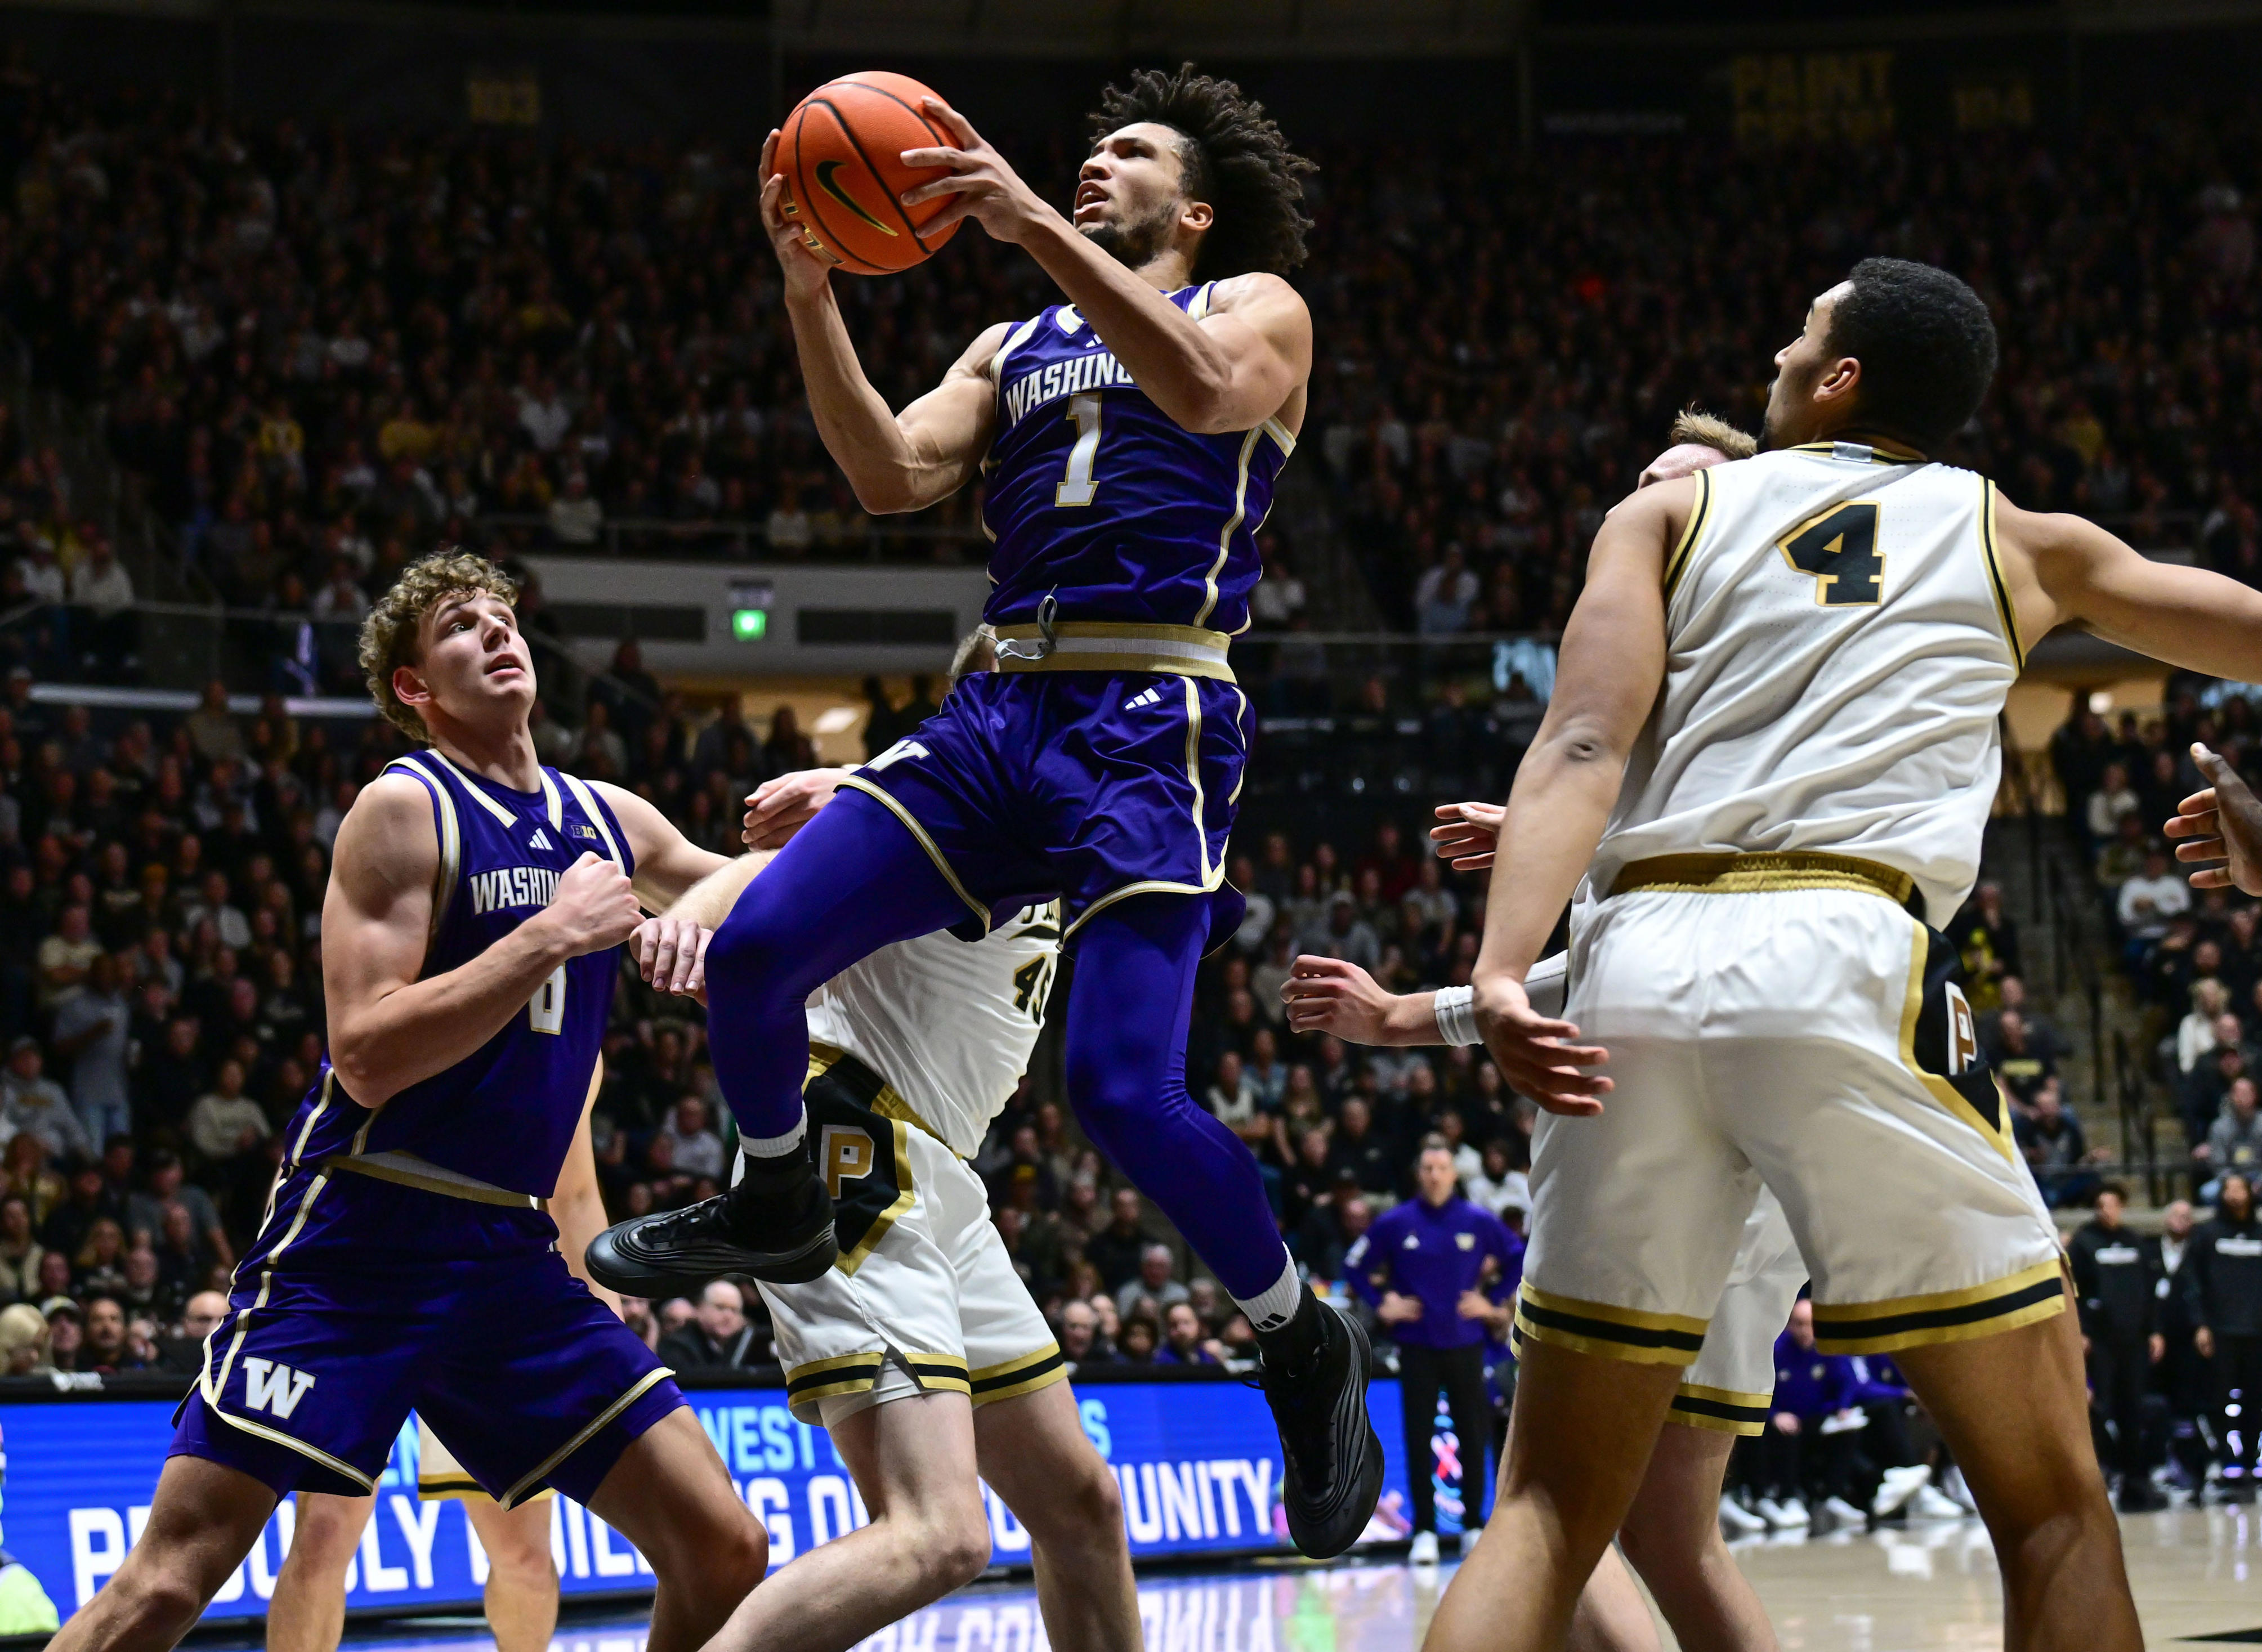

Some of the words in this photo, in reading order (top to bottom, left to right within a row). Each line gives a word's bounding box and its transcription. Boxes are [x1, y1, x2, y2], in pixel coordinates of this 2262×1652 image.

[1054, 392, 1103, 508] 1
[1775, 500, 1887, 607] 4
[1944, 980, 1978, 1076] P
[819, 1123, 875, 1200] P
[242, 1356, 316, 1420] W
